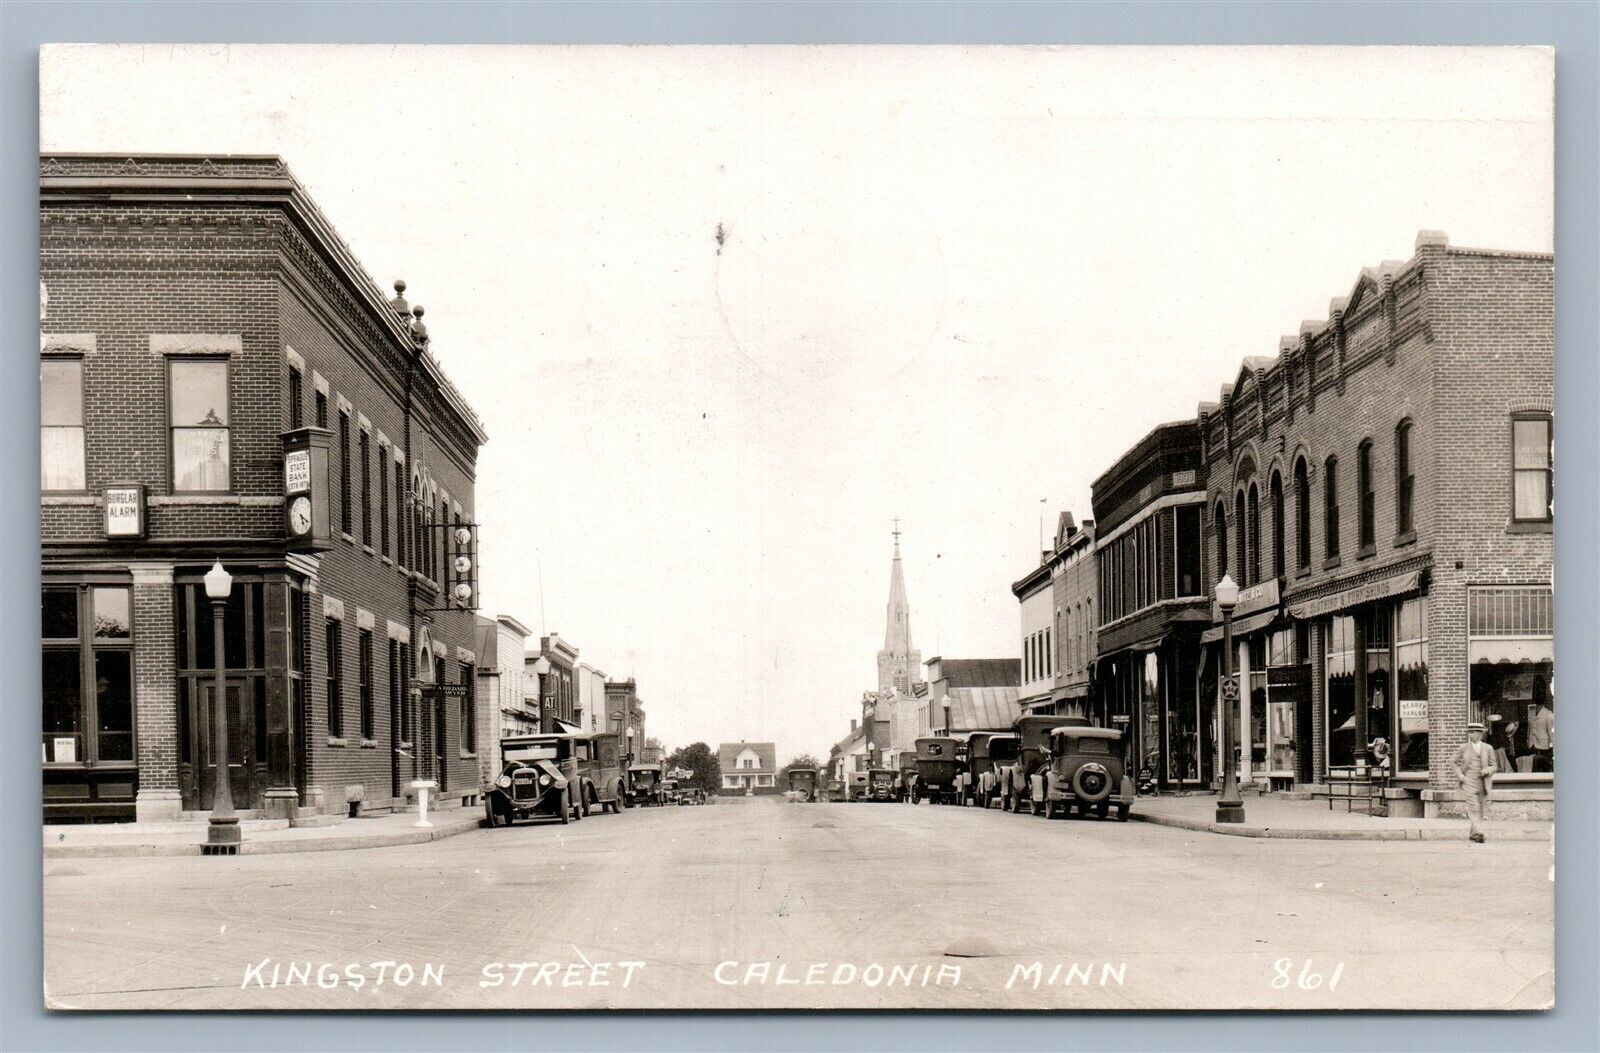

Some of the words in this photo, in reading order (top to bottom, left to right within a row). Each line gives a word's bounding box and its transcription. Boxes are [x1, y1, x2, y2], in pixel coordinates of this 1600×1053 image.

[289, 462, 306, 472] STATE
[288, 473, 308, 482] BANK
[107, 493, 137, 504] BURGLAR
[110, 507, 137, 518] ALARM
[1347, 580, 1390, 603] FURNISHINGS
[544, 696, 555, 709] AT
[1401, 702, 1426, 710] BEAUTY
